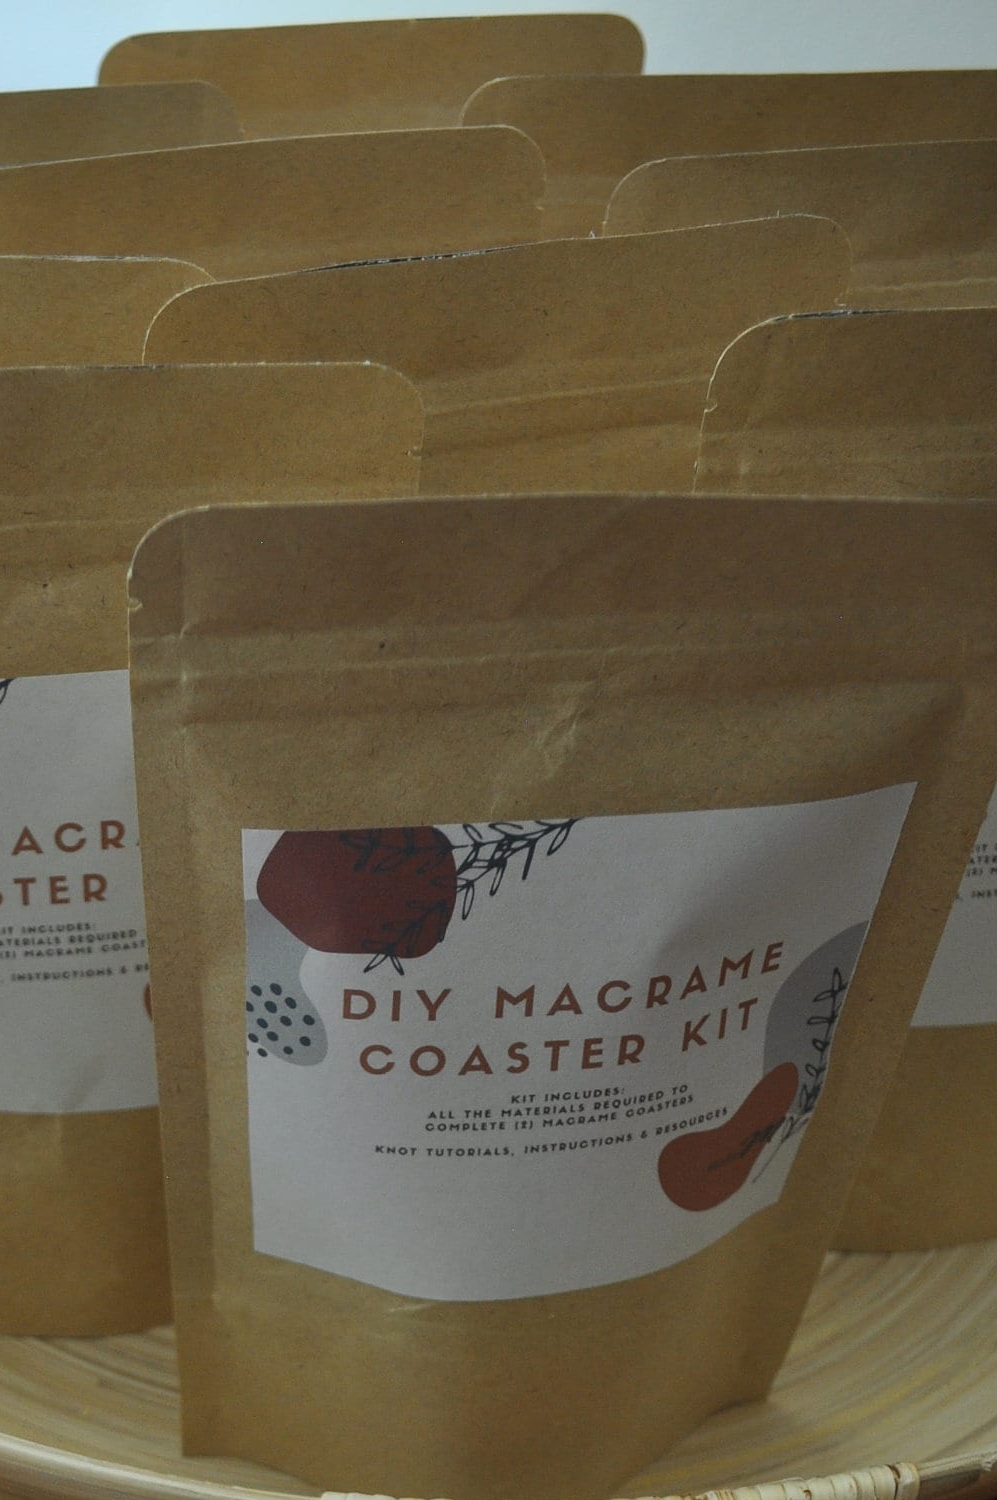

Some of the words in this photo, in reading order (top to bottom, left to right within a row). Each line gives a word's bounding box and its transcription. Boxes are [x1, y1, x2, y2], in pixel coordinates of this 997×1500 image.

[24, 946, 92, 958] MACRAME
[69, 928, 137, 944] REQUIRED
[11, 967, 112, 981] INSTRUCTIONS
[342, 988, 452, 1021] DIY
[495, 941, 784, 1019] MACRAME
[359, 1034, 646, 1077] COASTER
[682, 998, 759, 1051] KIT
[425, 1122, 505, 1131] COMPLETE
[515, 1120, 534, 1130] (2)
[542, 1112, 617, 1128] MACRAME
[626, 1094, 693, 1118] COASTERS
[428, 1110, 455, 1119] ALL
[464, 1109, 492, 1118] THE
[501, 1103, 585, 1118] MATERIALS
[594, 1091, 664, 1110] REQUIRED
[672, 1084, 688, 1096] TO
[511, 1094, 536, 1104] KIT
[544, 1087, 625, 1102] INCLUDES:
[375, 1145, 417, 1156] KNOT
[427, 1147, 514, 1157] TUTORIALS,
[524, 1133, 633, 1154] INSTRUCTIONS
[640, 1130, 647, 1139] &
[656, 1107, 728, 1135] RESOURCES
